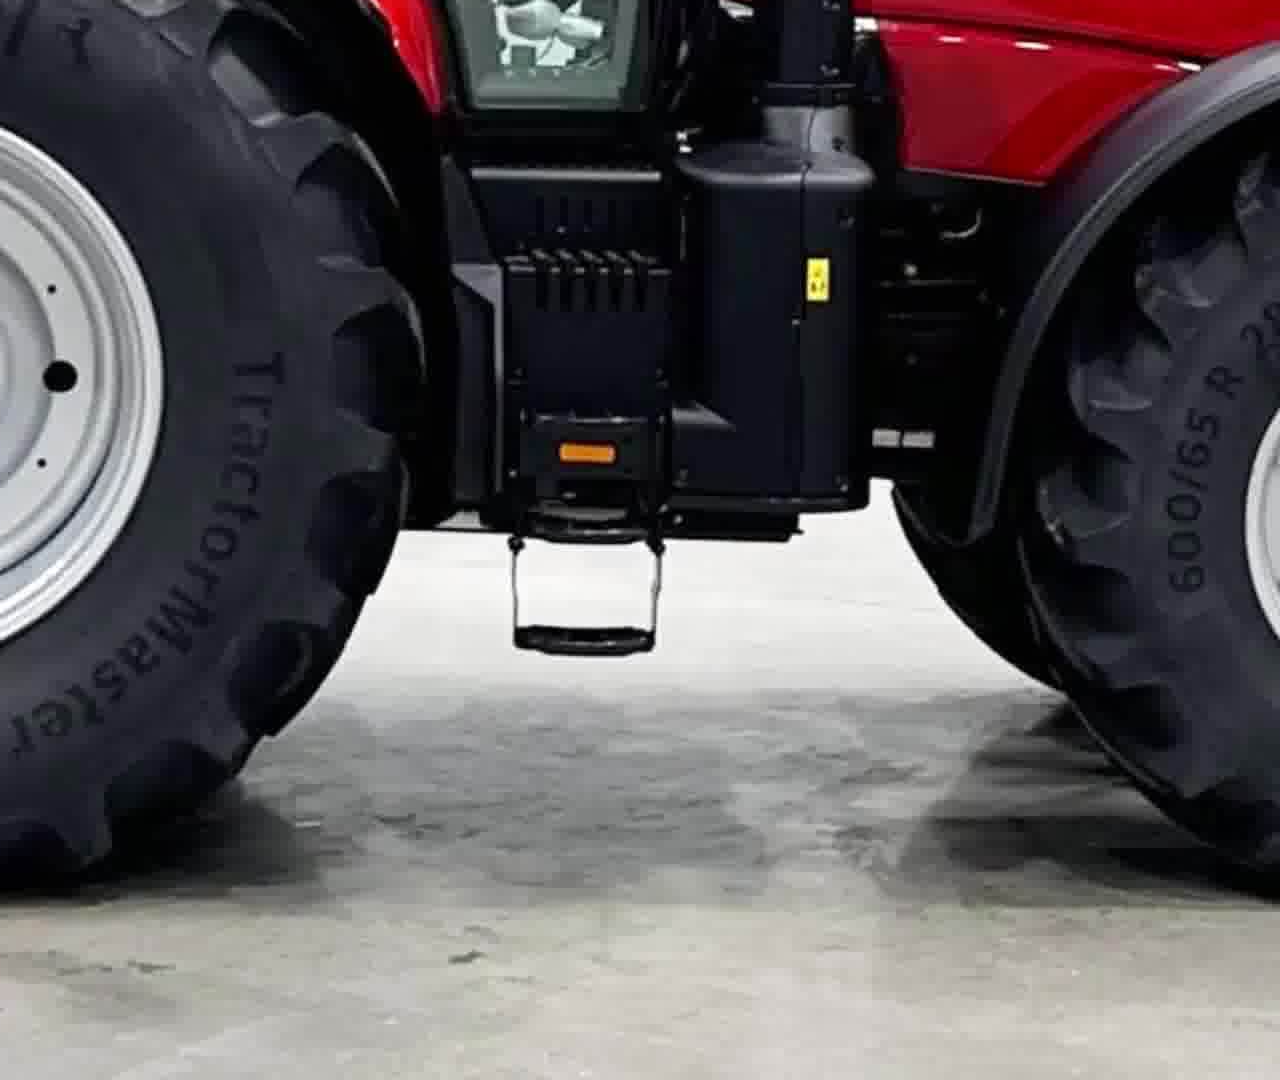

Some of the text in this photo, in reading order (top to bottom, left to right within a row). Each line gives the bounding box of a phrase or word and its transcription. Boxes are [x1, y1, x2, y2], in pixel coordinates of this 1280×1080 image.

[8, 351, 285, 760] TractorMaster
[1166, 407, 1221, 594] 600/65
[1204, 365, 1246, 401] R
